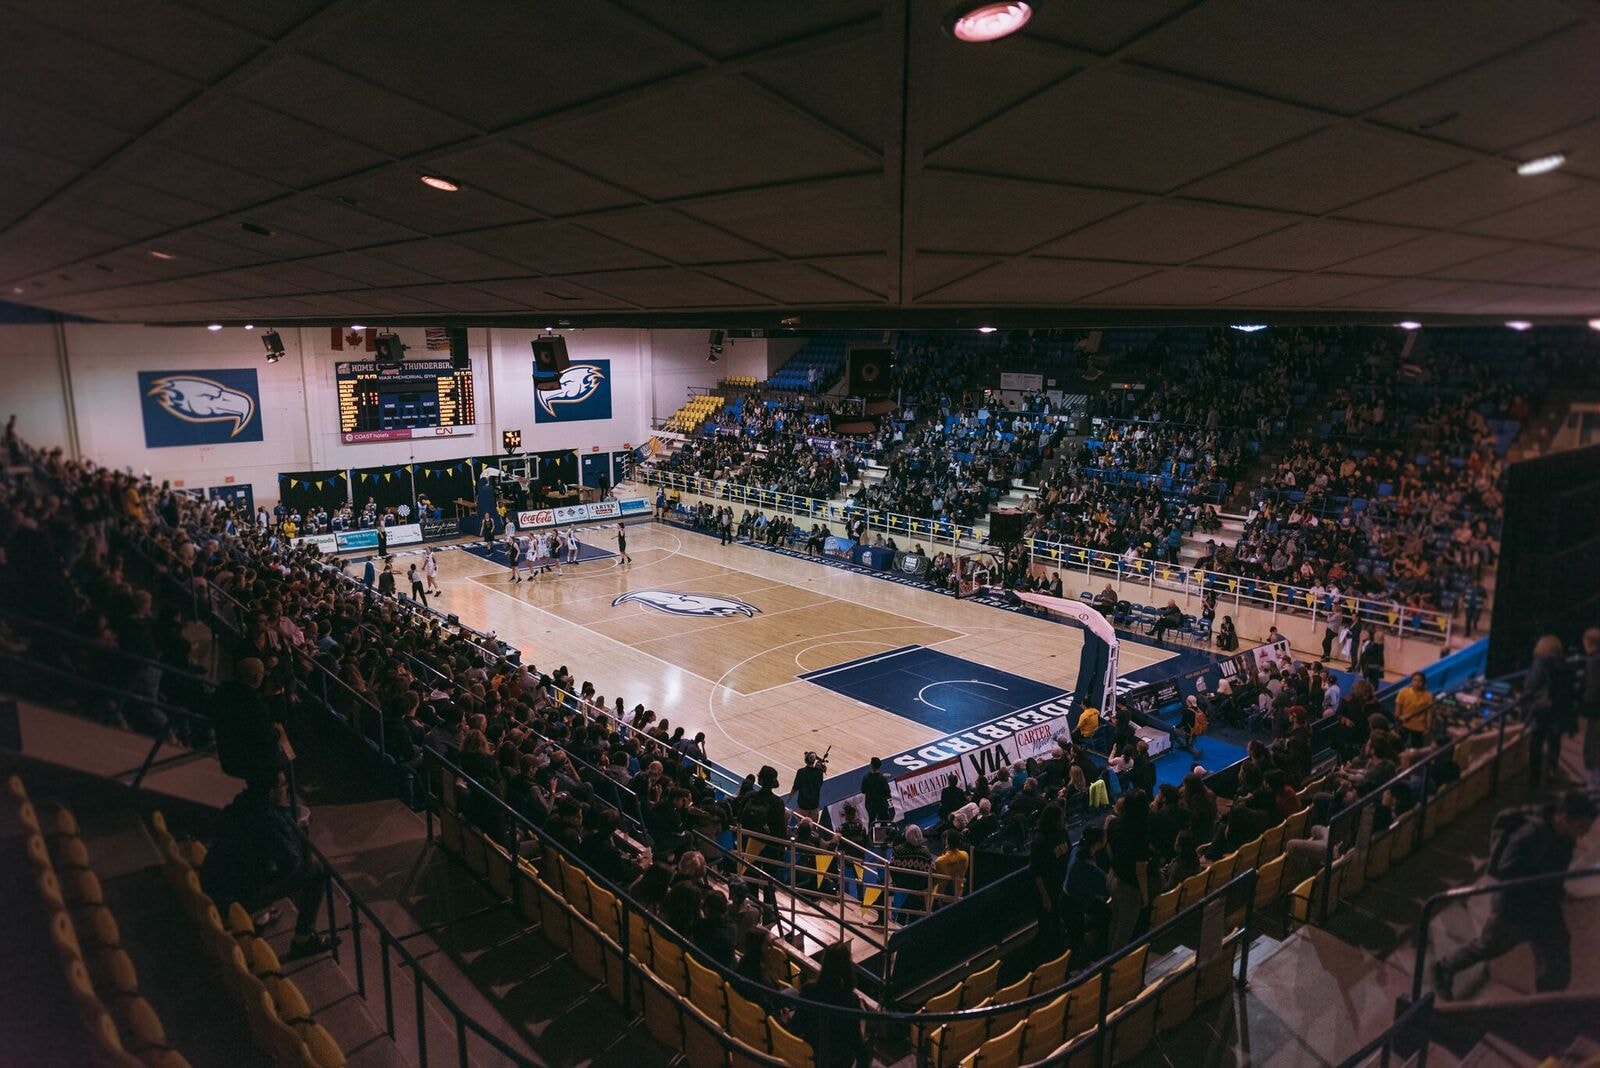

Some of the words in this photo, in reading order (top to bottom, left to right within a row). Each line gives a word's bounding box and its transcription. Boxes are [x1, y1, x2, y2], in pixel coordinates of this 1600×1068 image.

[351, 364, 374, 372] HOME
[404, 362, 454, 370] THUNDERBIR
[591, 503, 616, 511] CARTER
[775, 549, 850, 569] UNIVERSITY
[850, 566, 872, 574] OF
[871, 571, 931, 589] BRITISH
[1219, 658, 1238, 679] VIA
[1017, 724, 1052, 747] CARTER
[968, 743, 1012, 777] VIA
[918, 768, 963, 796] CANADIN
